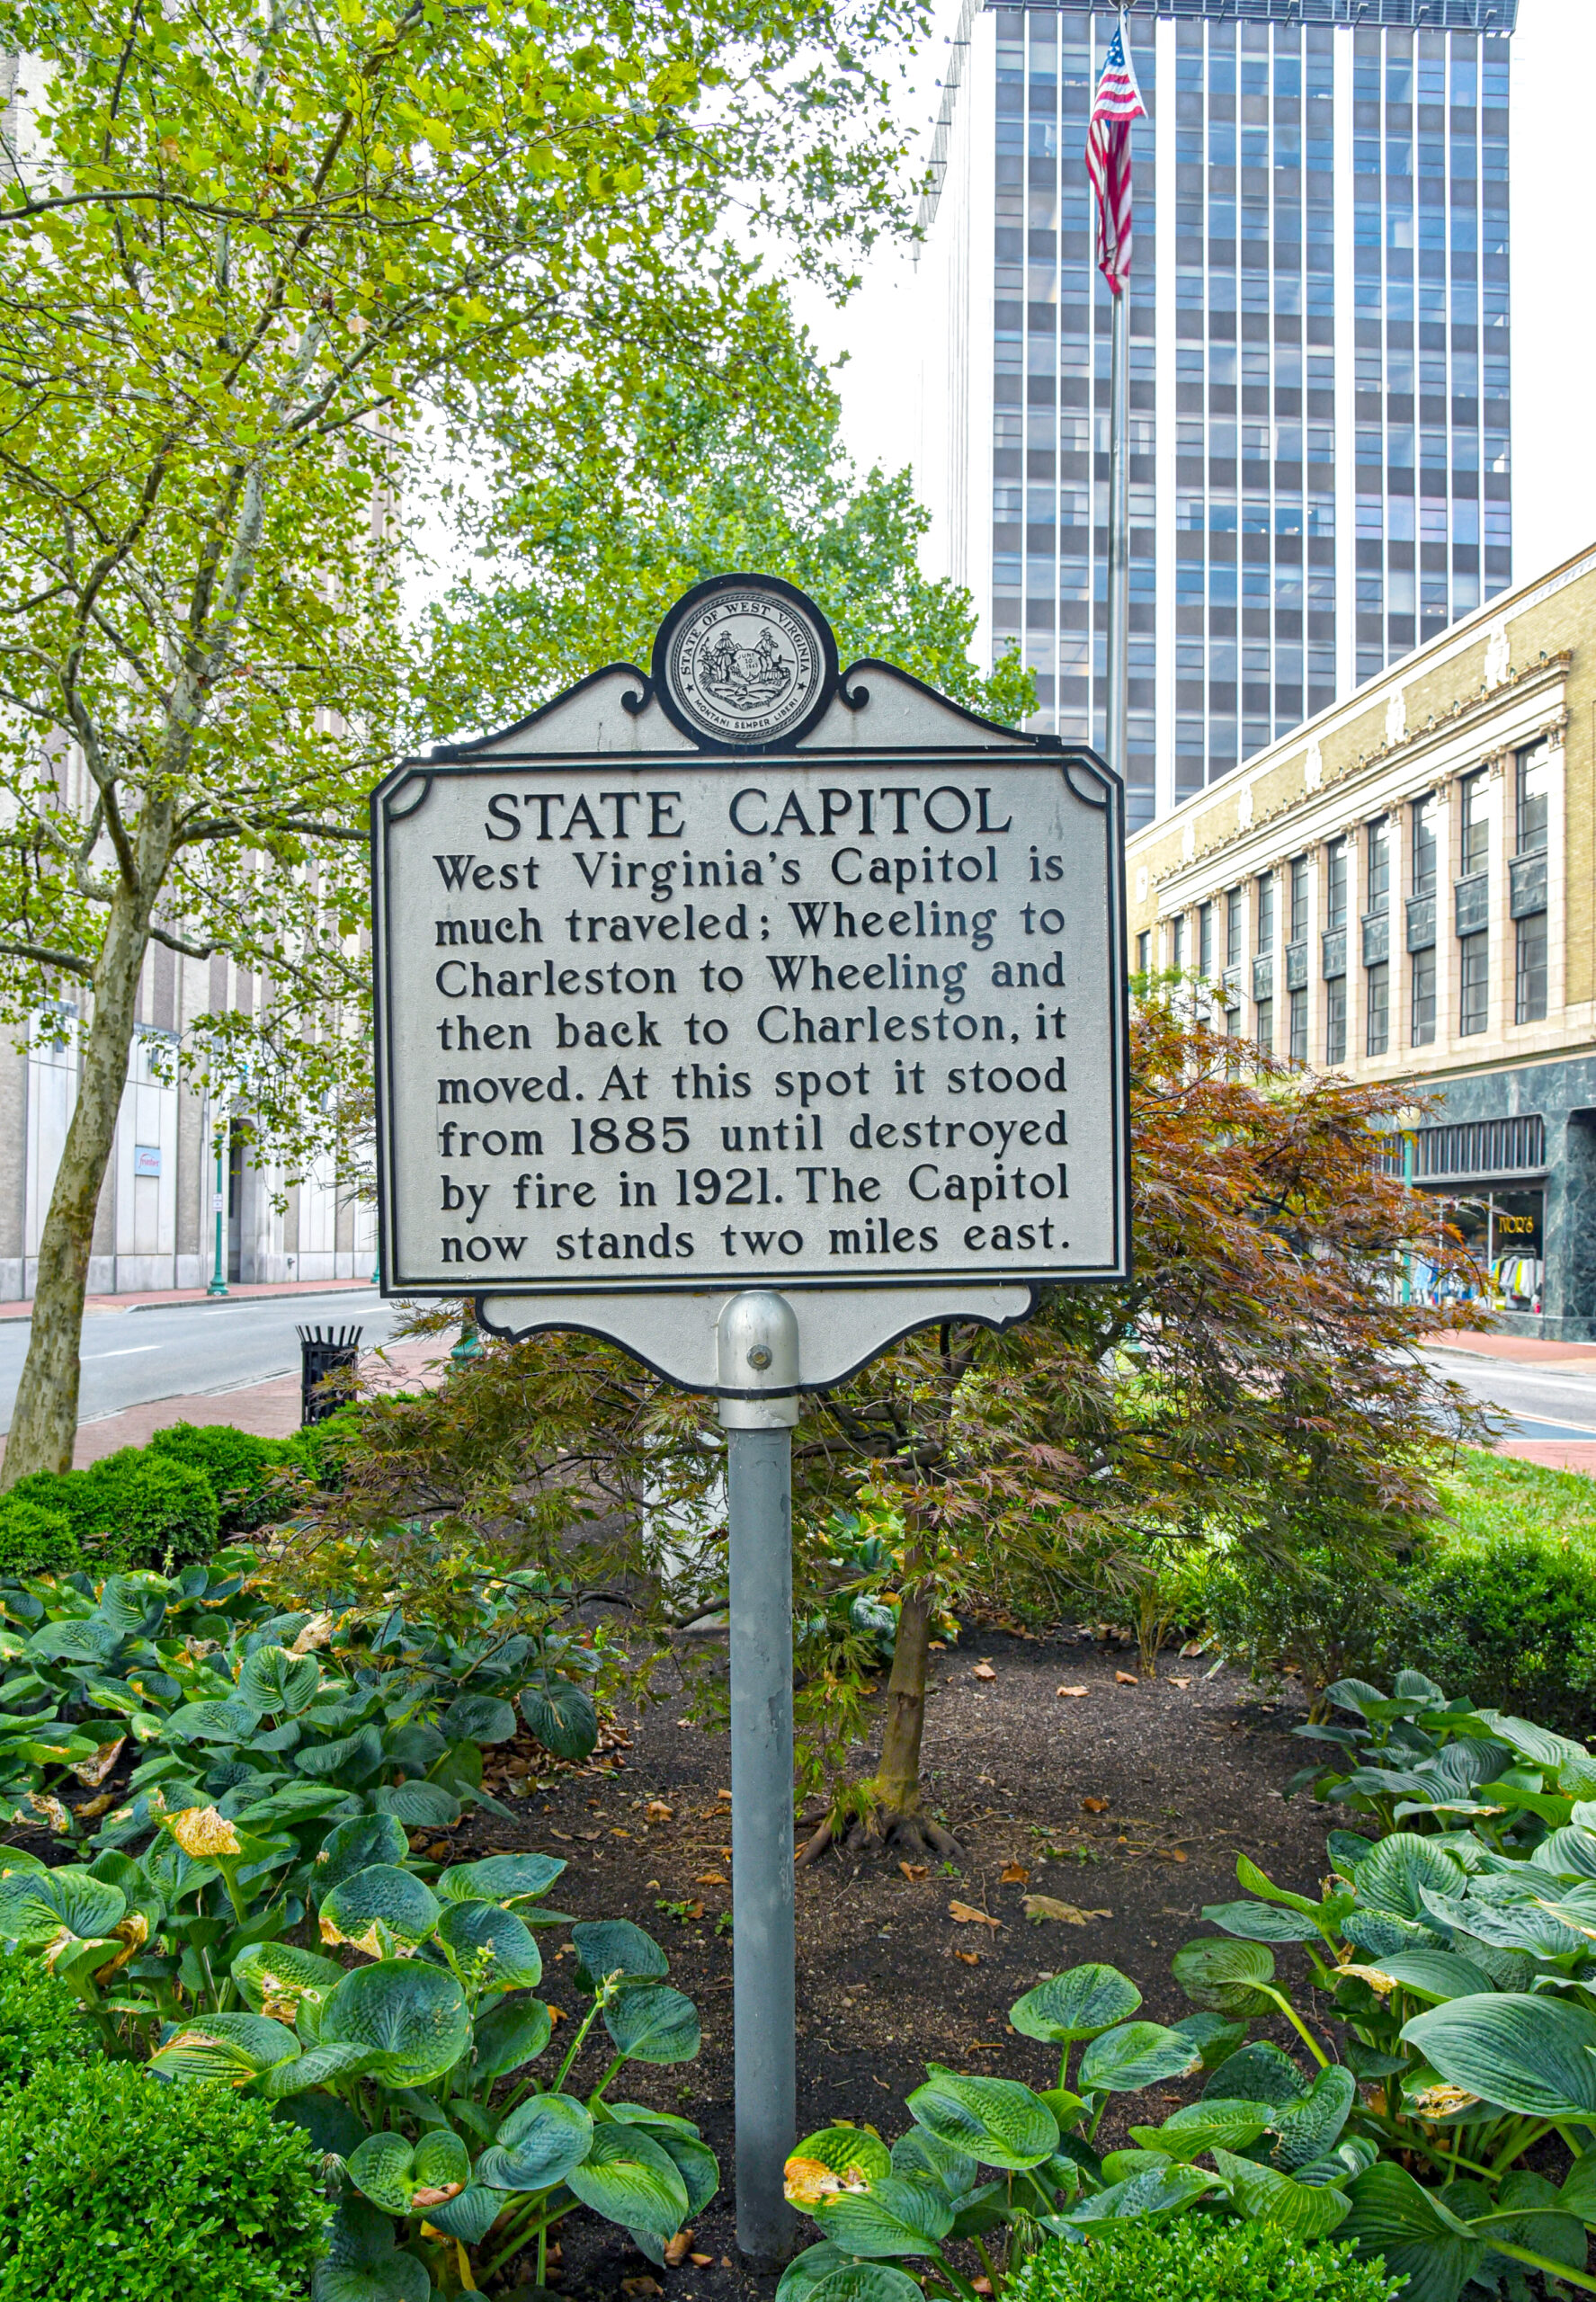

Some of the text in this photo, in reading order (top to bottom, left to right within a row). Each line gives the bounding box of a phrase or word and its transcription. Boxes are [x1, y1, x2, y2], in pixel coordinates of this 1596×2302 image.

[681, 602, 811, 675] STATE OF WEST VIRGINIA
[694, 698, 798, 729] MONTANI SEMPER LIBERI
[484, 785, 1012, 842] STATE CAPITOL
[432, 844, 1064, 904] West Virginia's Capitol is
[435, 900, 1065, 951] much traveled; Wheeling to
[435, 950, 1065, 1004] Charleston to Wheeling and
[436, 1003, 1066, 1051] then back to Charleston, it
[437, 1056, 1067, 1108] moved. At this spot it stood
[438, 1109, 1068, 1160] from 1885 until destroyed
[441, 1163, 1069, 1225] by fire in 1921. The Capitol
[441, 1217, 1069, 1263] now stands two miles east.
